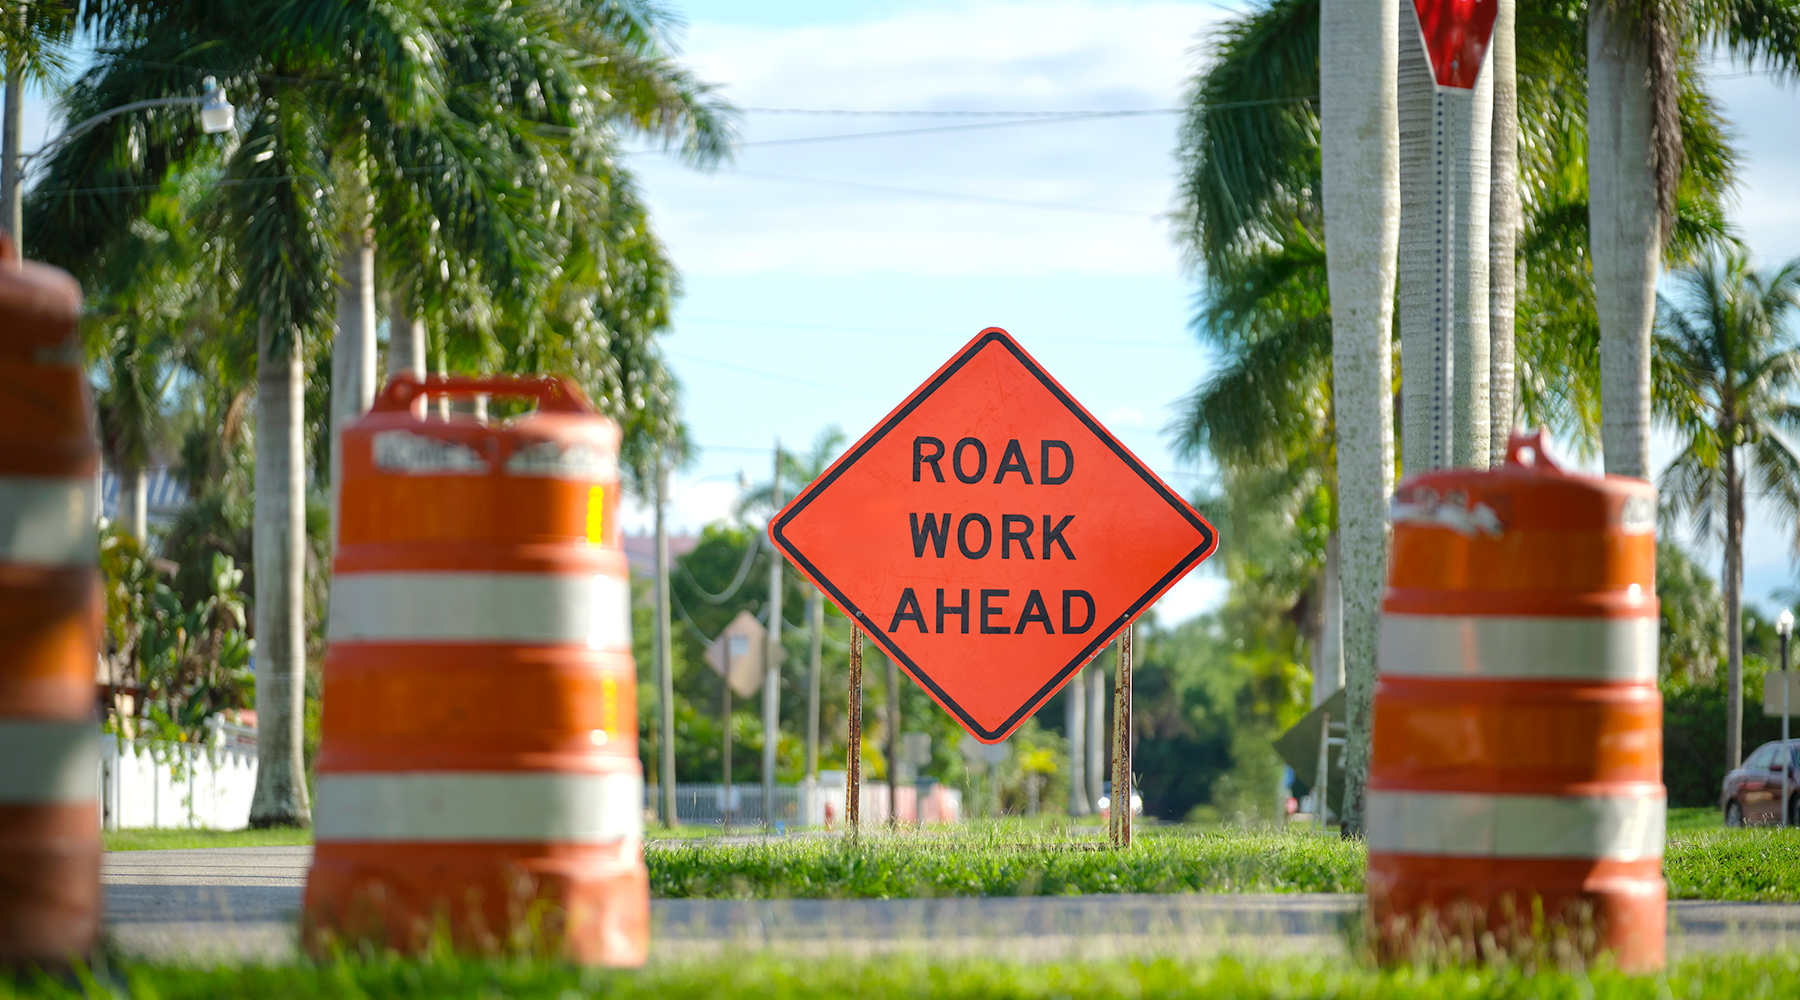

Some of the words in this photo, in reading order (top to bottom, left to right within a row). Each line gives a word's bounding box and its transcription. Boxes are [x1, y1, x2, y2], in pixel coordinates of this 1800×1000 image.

[912, 436, 1075, 486] ROAD
[909, 512, 1077, 561] WORK
[888, 588, 1096, 635] AHEAD
